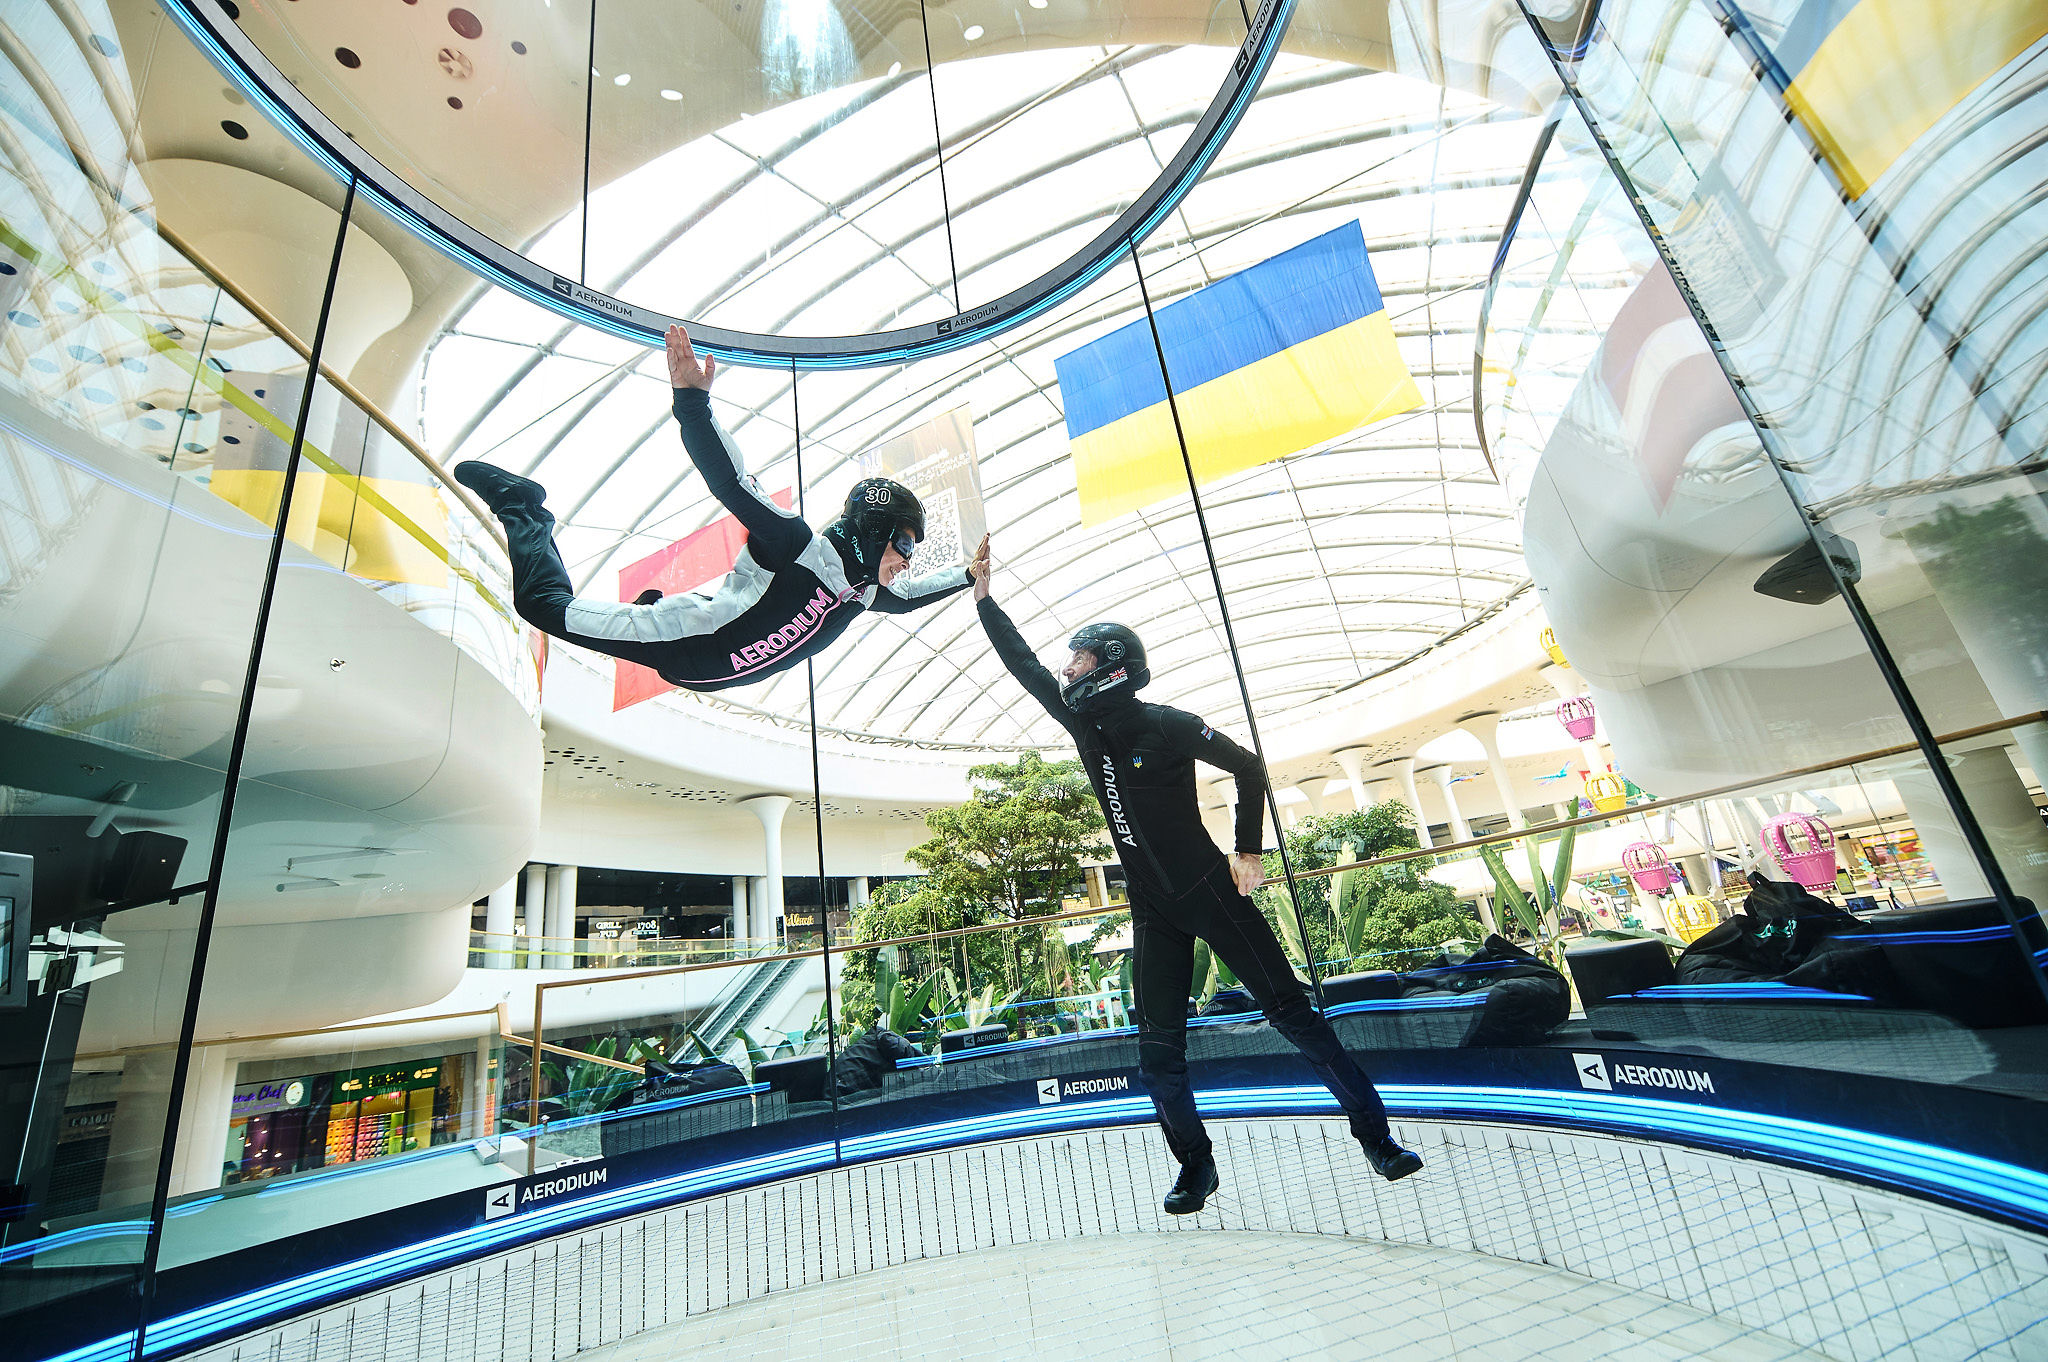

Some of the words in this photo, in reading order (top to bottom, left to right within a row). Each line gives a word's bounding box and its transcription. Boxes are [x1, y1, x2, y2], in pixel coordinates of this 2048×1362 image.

[575, 290, 633, 318] AERODIUM
[954, 304, 999, 328] AERODIUM
[865, 487, 891, 504] 30
[730, 587, 834, 671] AERODIUM
[1103, 755, 1138, 848] AERODIUM
[637, 919, 657, 931] 1708
[976, 1031, 1010, 1043] AERODIUM
[1063, 1076, 1129, 1096] AERODIUM
[1614, 1063, 1716, 1094] AERODIUM
[520, 1167, 607, 1204] AERODIUM
